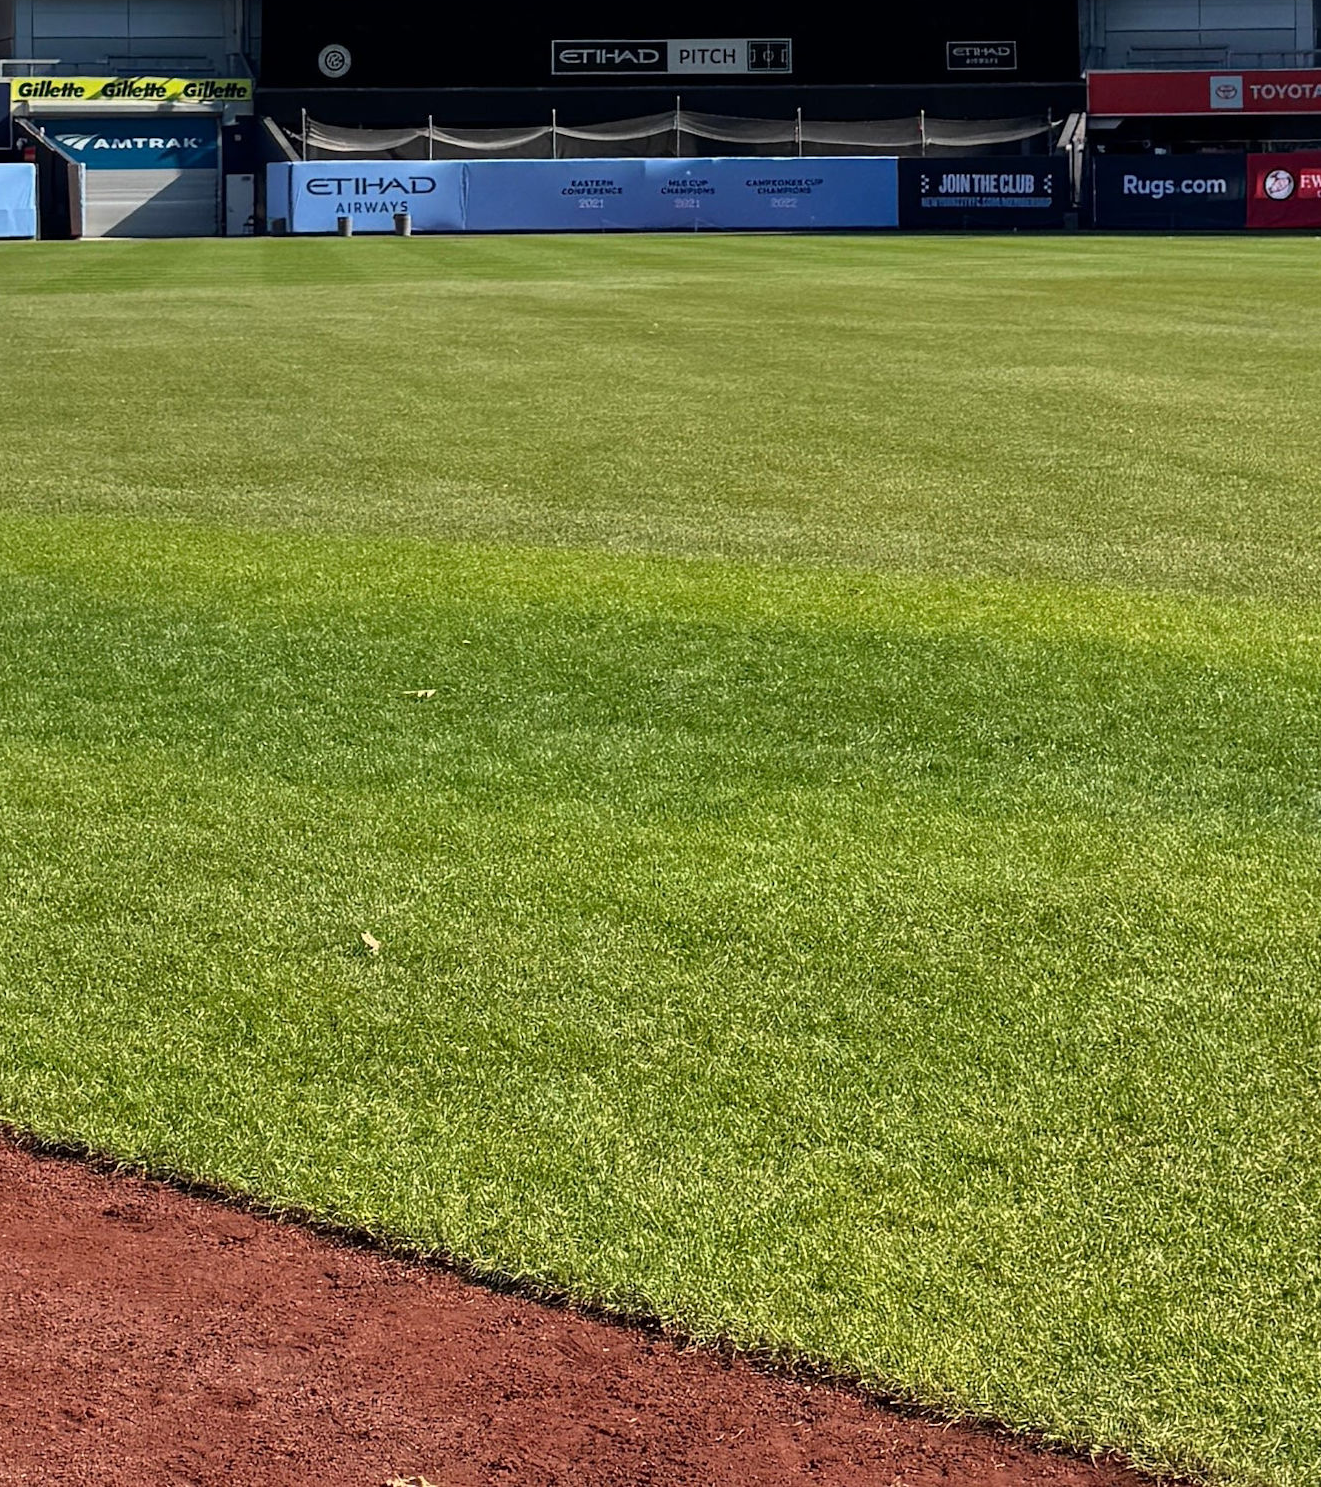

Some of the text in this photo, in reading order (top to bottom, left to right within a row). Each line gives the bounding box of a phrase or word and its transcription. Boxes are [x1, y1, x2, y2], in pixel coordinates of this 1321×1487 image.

[558, 49, 736, 65] ETIHAD PITCH
[18, 80, 248, 100] Gillette Gillette Gillette
[93, 137, 199, 150] AMTRAK
[305, 176, 437, 195] ETIHAD
[938, 174, 1035, 193] JOIN THE CLUB
[1123, 175, 1227, 199] Rugs.com
[335, 200, 409, 214] AIRWAYS
